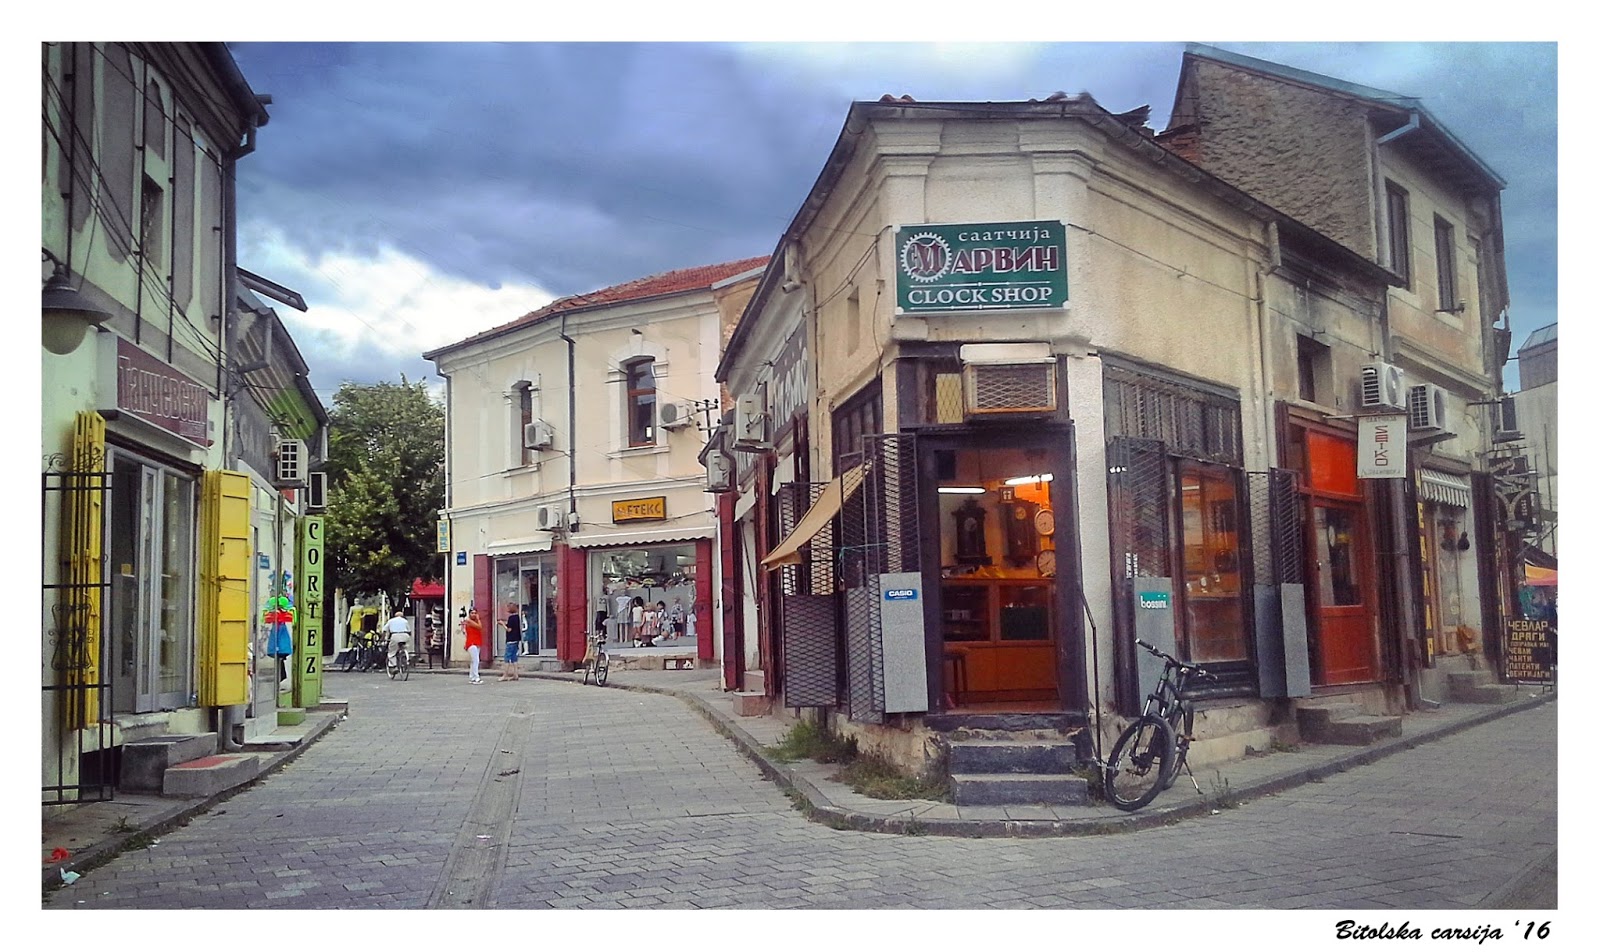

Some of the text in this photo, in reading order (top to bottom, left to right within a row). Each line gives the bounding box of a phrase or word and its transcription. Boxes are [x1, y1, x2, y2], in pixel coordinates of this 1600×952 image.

[958, 227, 1050, 243] саатчија
[907, 286, 1053, 305] CLOCK SHOP
[1374, 425, 1389, 467] SEIKO
[306, 522, 319, 674] CORTEZ
[1140, 594, 1167, 609] bossini
[1508, 620, 1549, 631] ЧЕВЛАР
[1511, 632, 1545, 641] ДРАГИ
